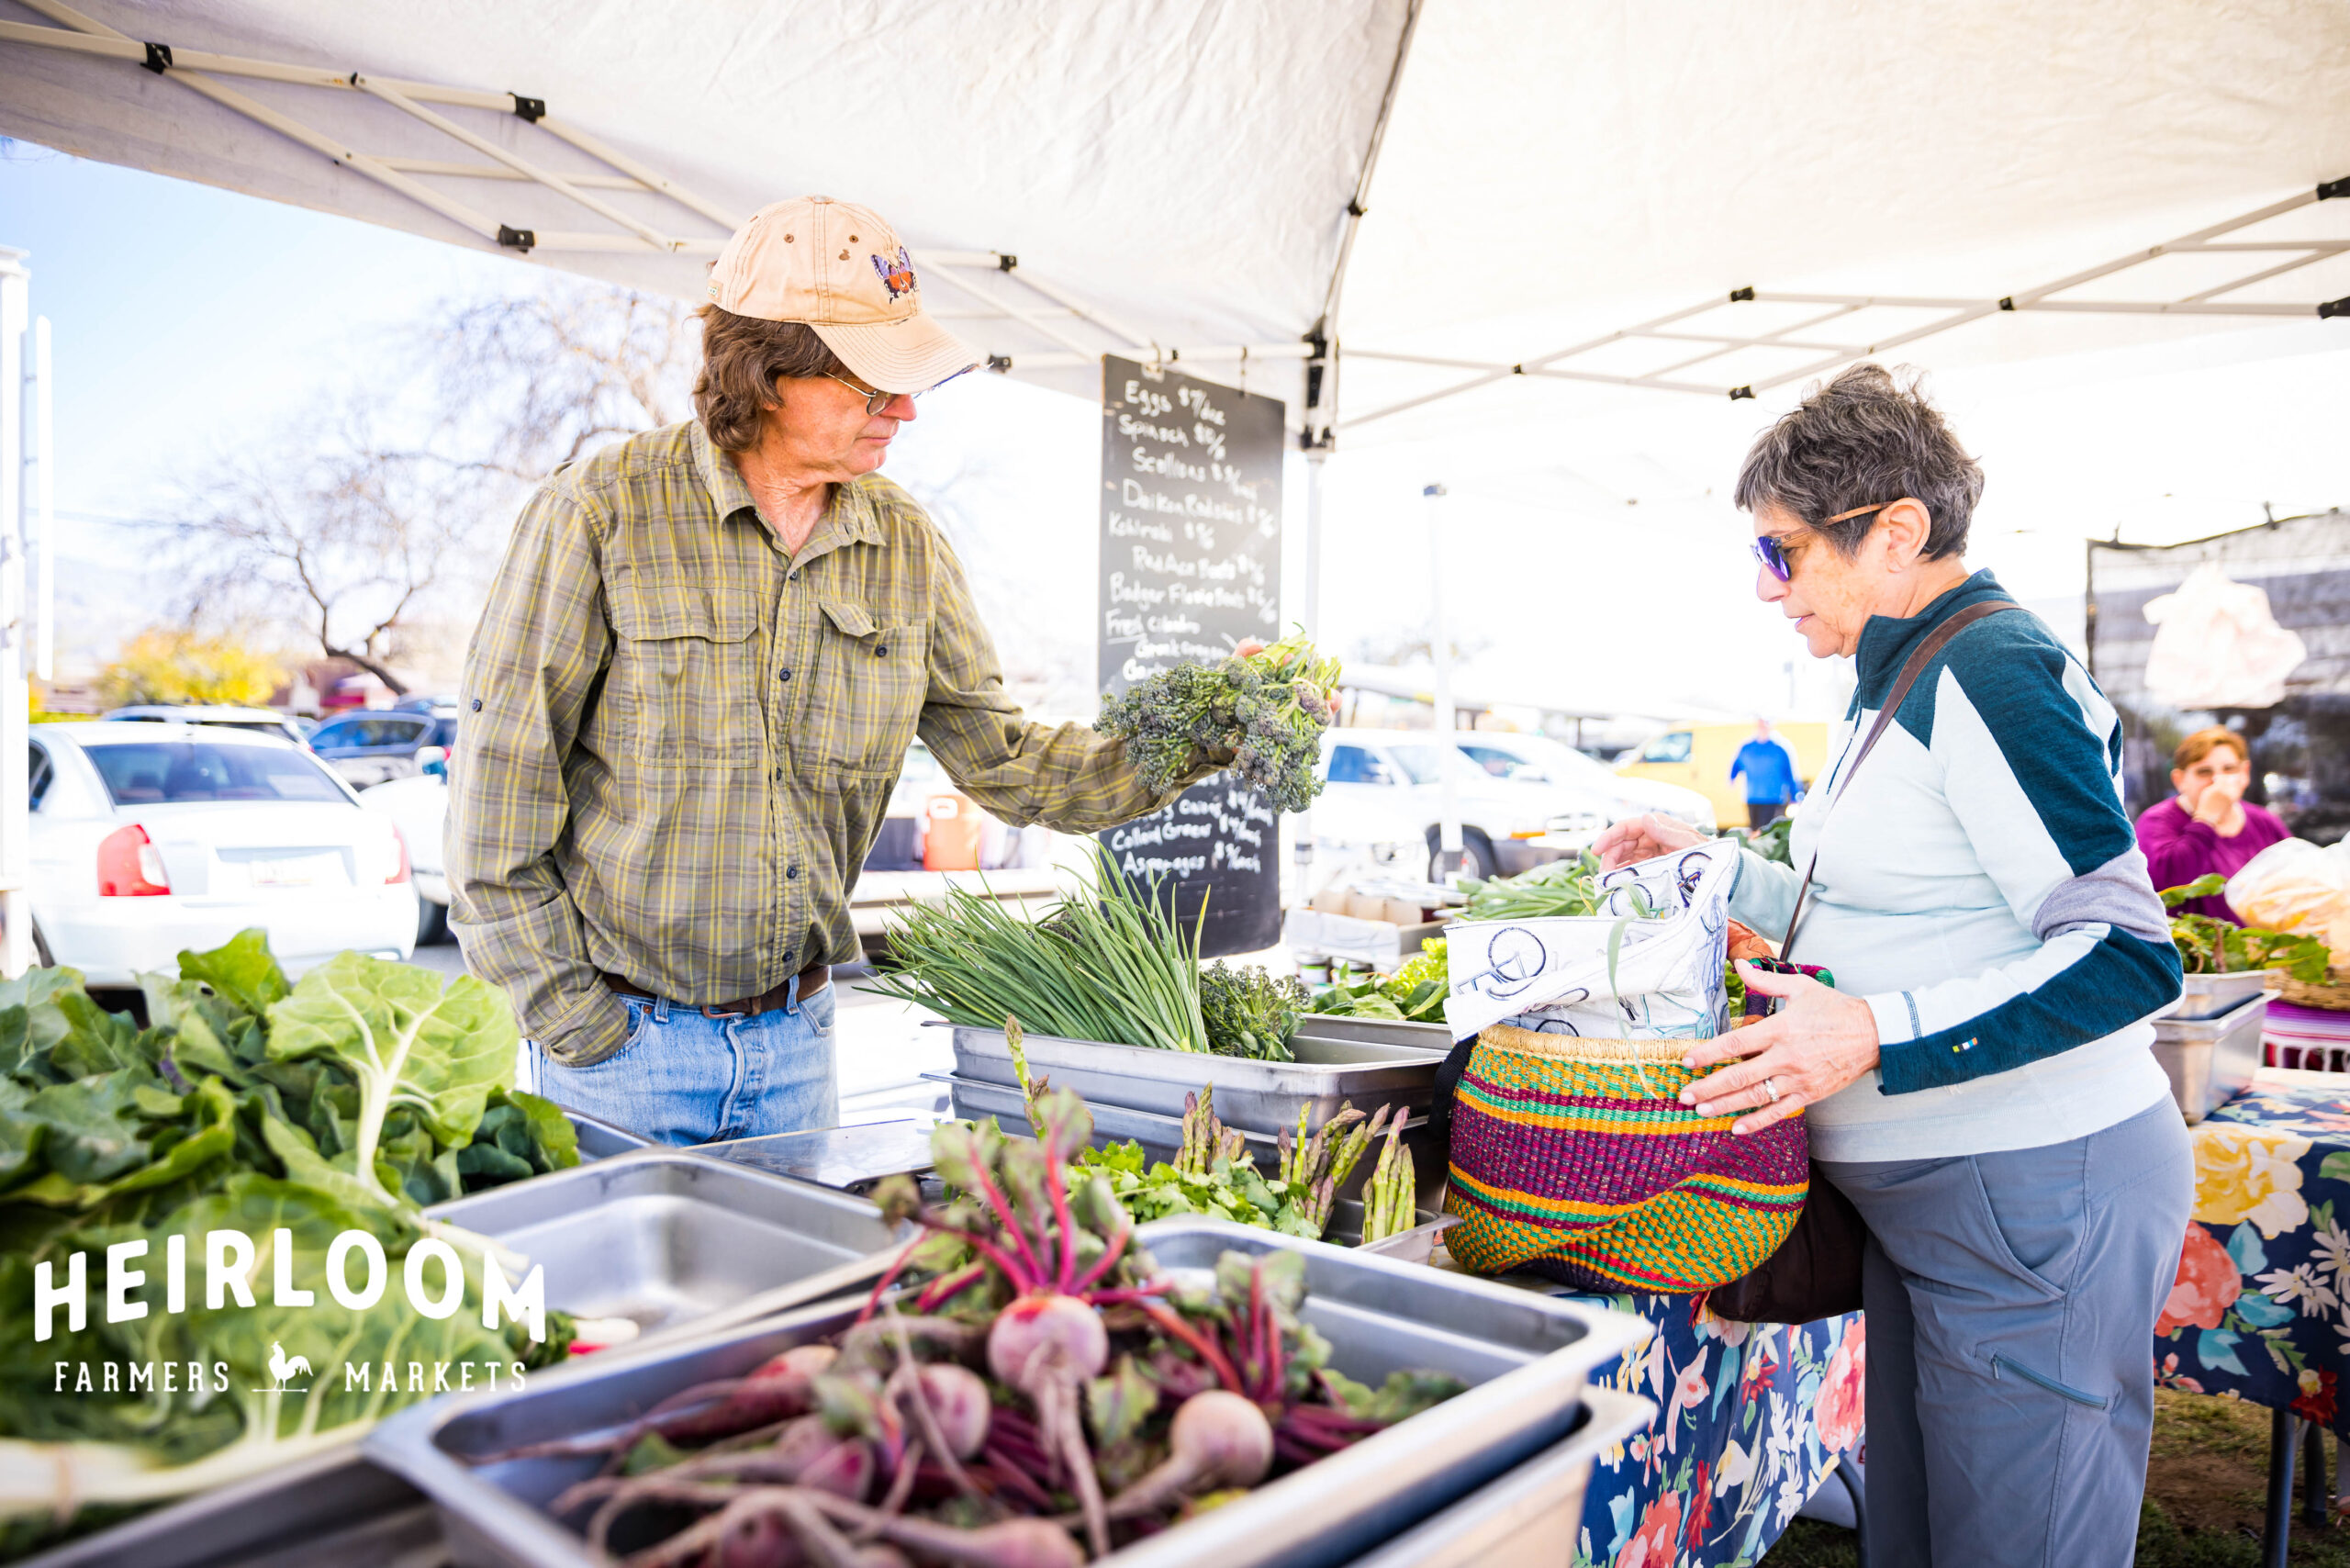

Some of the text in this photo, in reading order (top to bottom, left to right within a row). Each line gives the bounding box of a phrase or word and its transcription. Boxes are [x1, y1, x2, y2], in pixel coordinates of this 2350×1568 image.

[1125, 379, 1172, 418] Eggs
[1118, 414, 1190, 448] Spinach
[1132, 445, 1206, 483] Scallions
[1123, 477, 1184, 516] Daikon
[1109, 510, 1173, 544] Kohlrabi
[1132, 544, 1163, 573] Red
[1110, 571, 1166, 612] Badger
[1111, 824, 1163, 852] Collard
[1162, 821, 1212, 841] Greens
